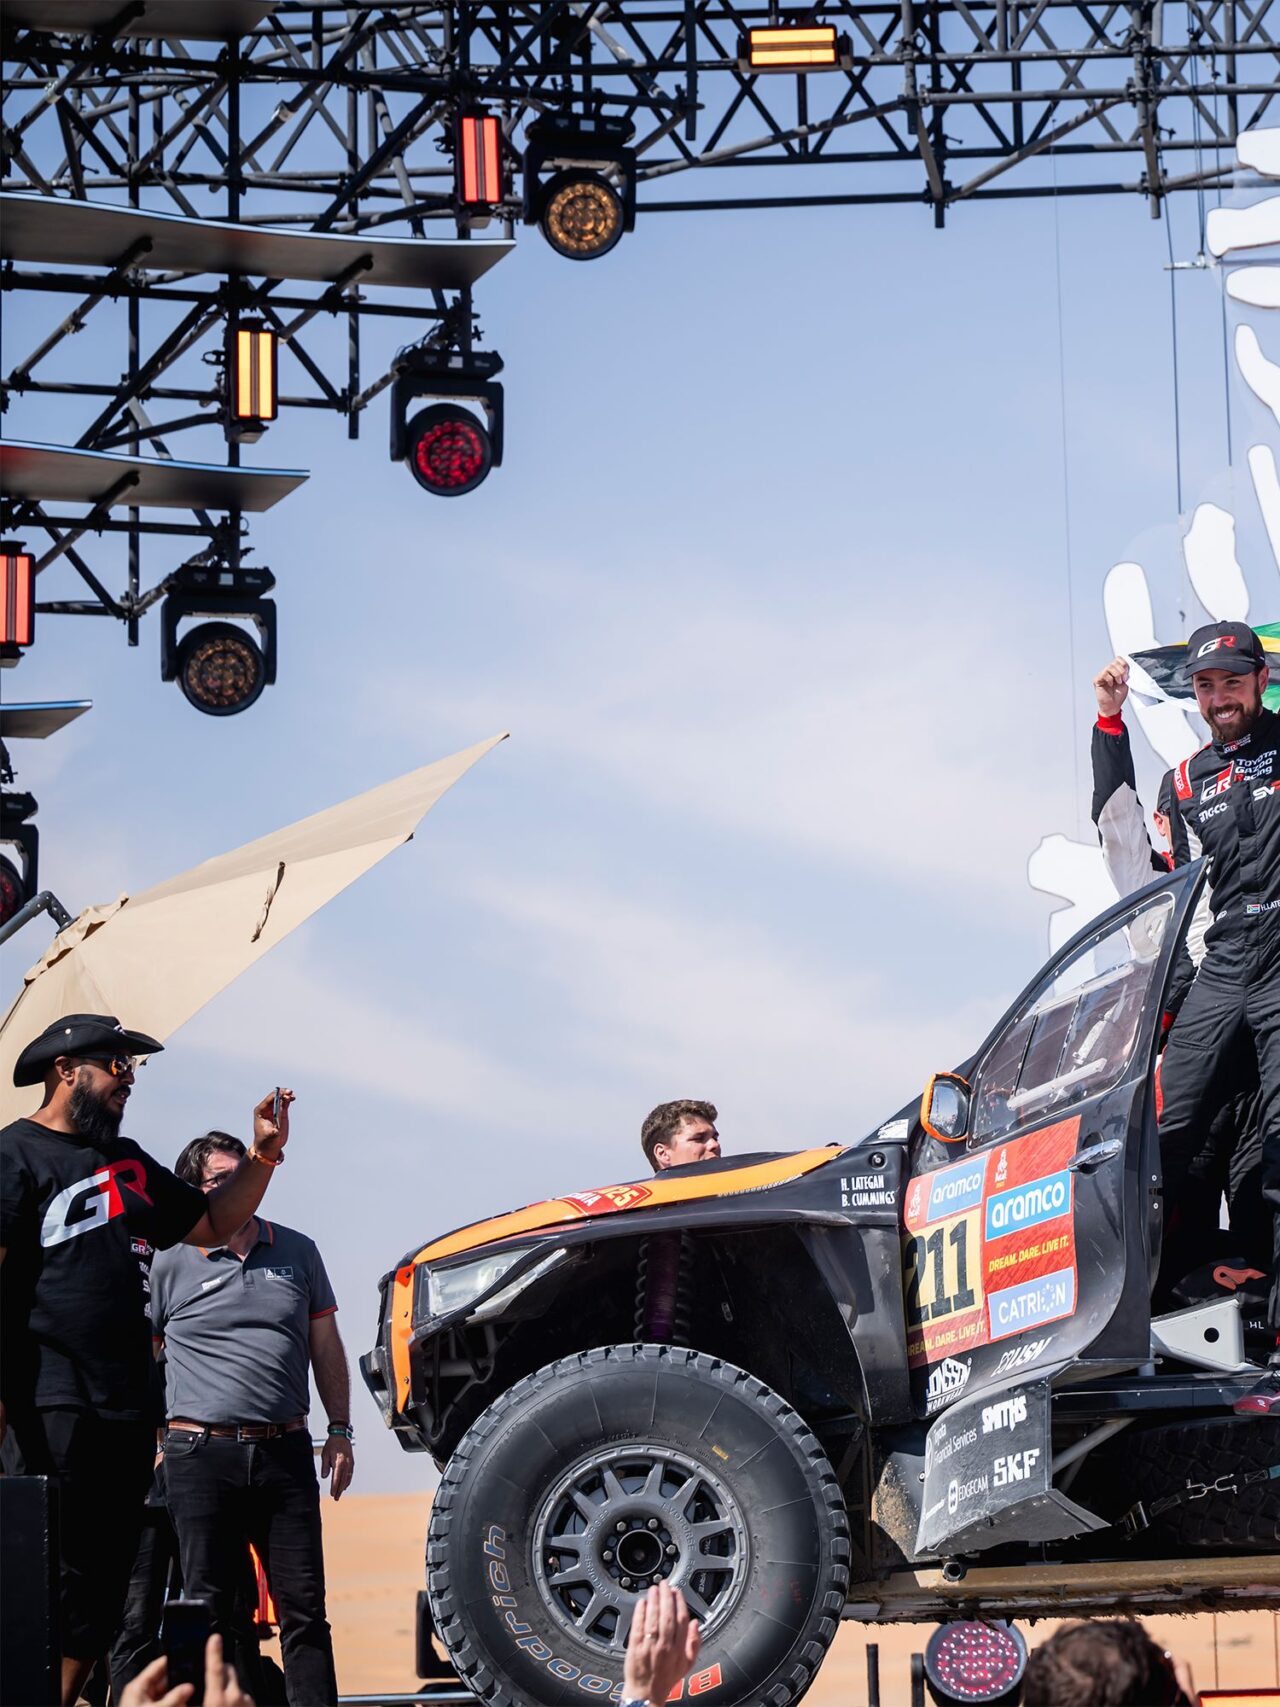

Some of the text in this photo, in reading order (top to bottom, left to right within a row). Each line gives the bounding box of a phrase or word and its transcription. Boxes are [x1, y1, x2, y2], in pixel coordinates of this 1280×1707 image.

[1197, 635, 1236, 658] GR
[1235, 757, 1273, 774] GAZOO
[1236, 750, 1277, 766] TOYOTA
[1234, 765, 1272, 782] Racing
[1201, 776, 1232, 803] GR
[841, 1175, 885, 1191] H. LATEGAN
[932, 1171, 982, 1204] aramco
[40, 1159, 154, 1248] GR
[842, 1191, 895, 1207] B. CUMMINGS
[992, 1181, 1065, 1229] aramco
[989, 1235, 1069, 1273] DREAM. DARE. LIVE IT.
[905, 1219, 975, 1327] 211
[999, 1282, 1066, 1324] CATRION
[936, 1330, 958, 1347] DARE.
[959, 1323, 976, 1339] LIVE
[926, 1358, 971, 1399] JONSSON
[953, 1428, 977, 1453] Services
[993, 1448, 1040, 1487] SKF
[958, 1473, 989, 1501] EDGECAM
